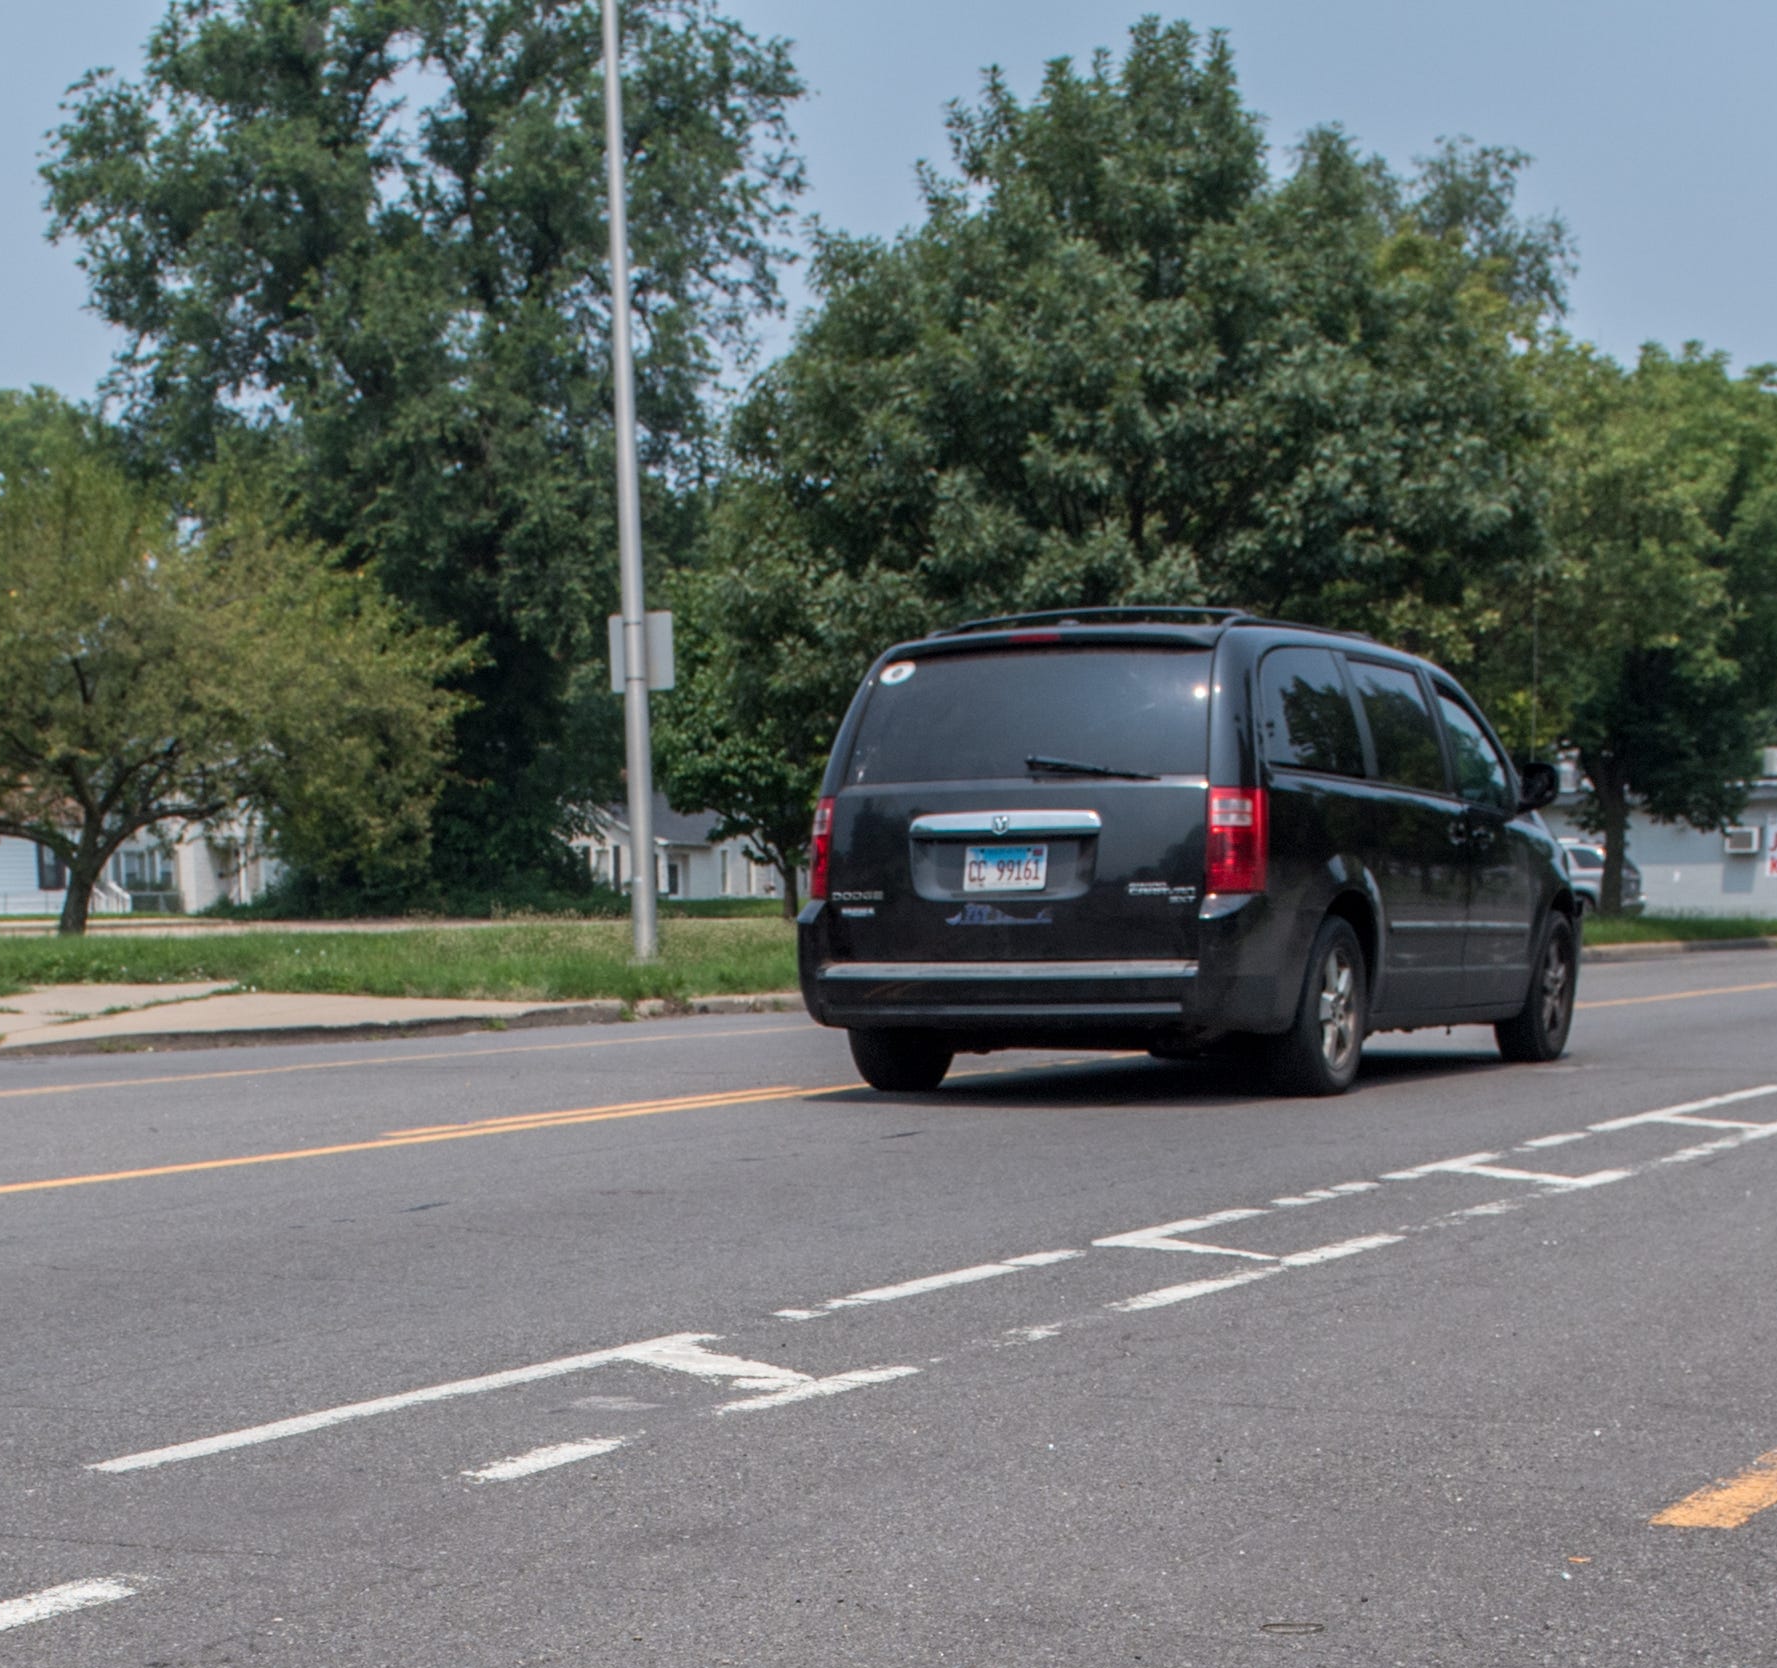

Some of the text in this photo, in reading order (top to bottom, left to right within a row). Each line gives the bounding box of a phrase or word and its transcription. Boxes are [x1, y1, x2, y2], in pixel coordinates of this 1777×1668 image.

[968, 858, 1040, 882] CC 99161
[832, 891, 884, 901] DODGE
